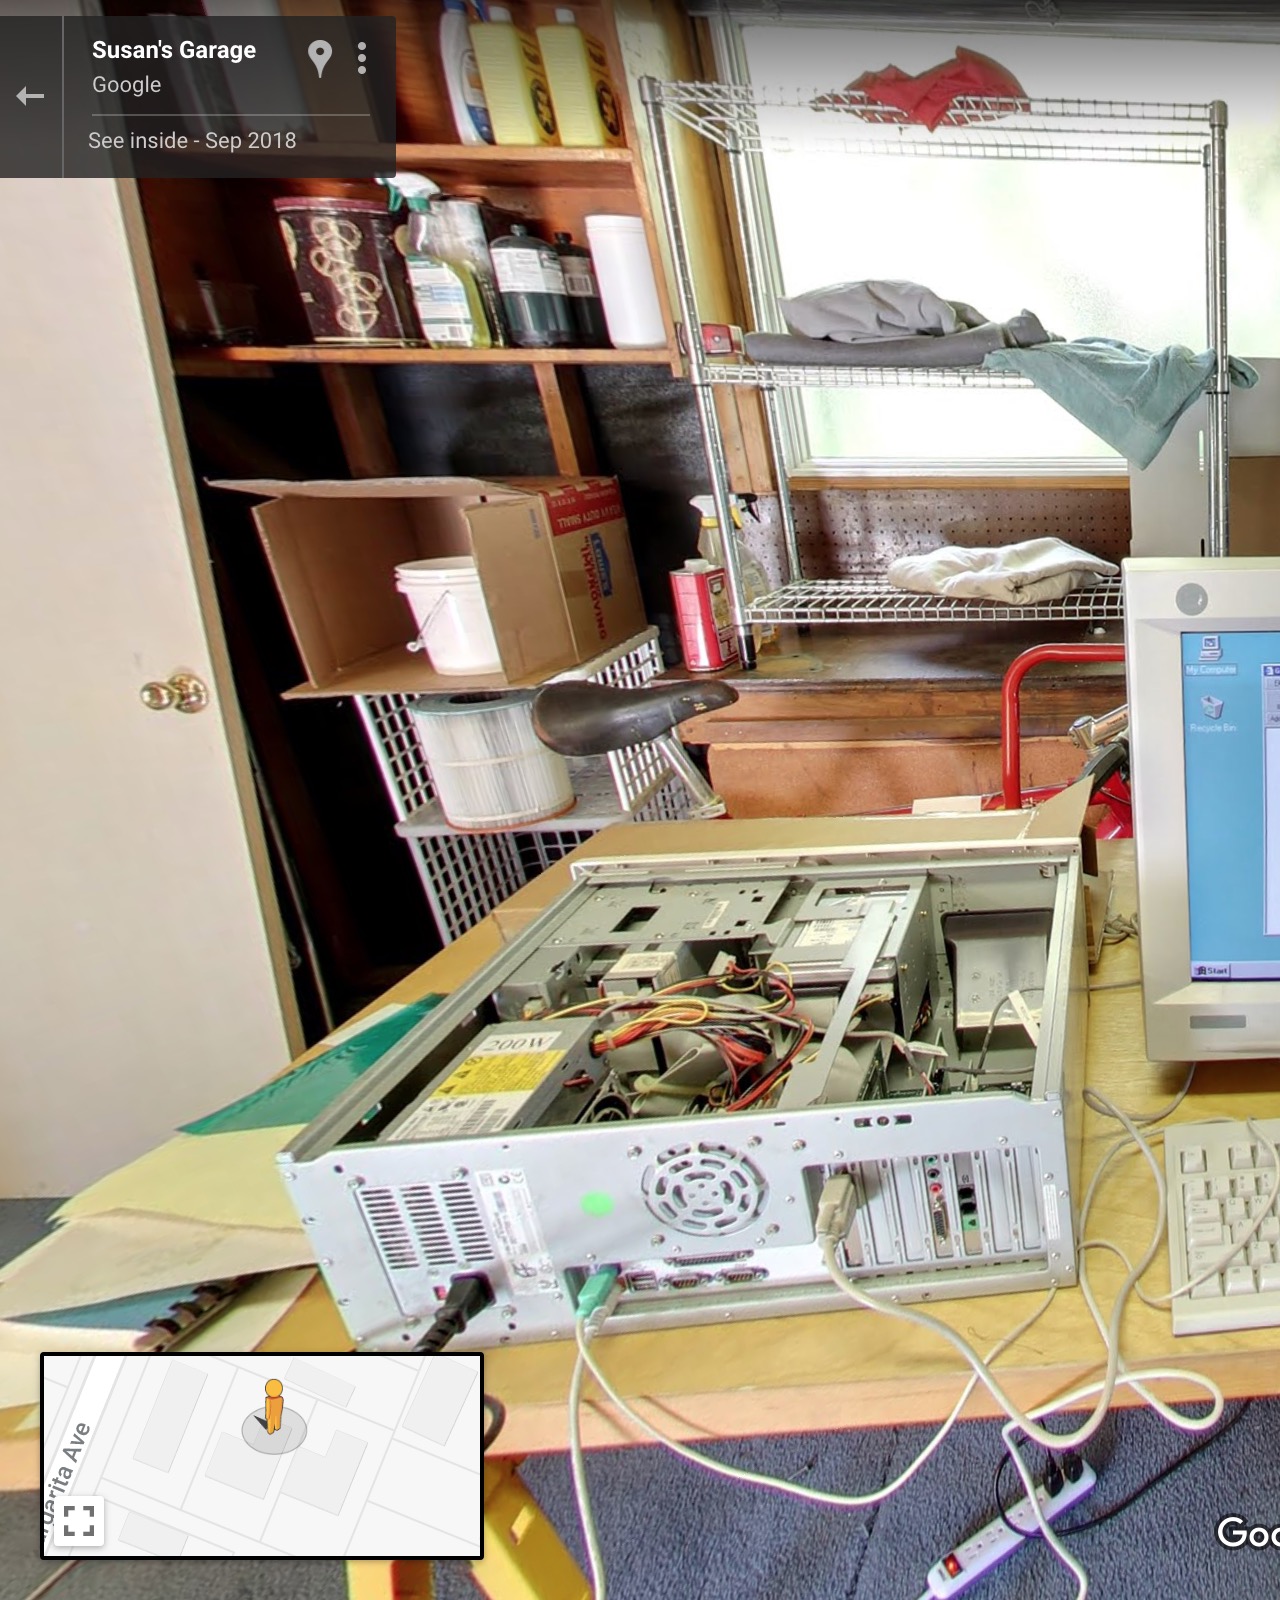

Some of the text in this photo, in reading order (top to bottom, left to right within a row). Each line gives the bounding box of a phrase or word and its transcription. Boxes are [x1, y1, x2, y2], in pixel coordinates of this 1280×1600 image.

[581, 546, 608, 640] IMPROVING
[1186, 665, 1237, 676] My Computer
[1190, 723, 1236, 734] Recycle Bin
[1207, 967, 1228, 976] Start
